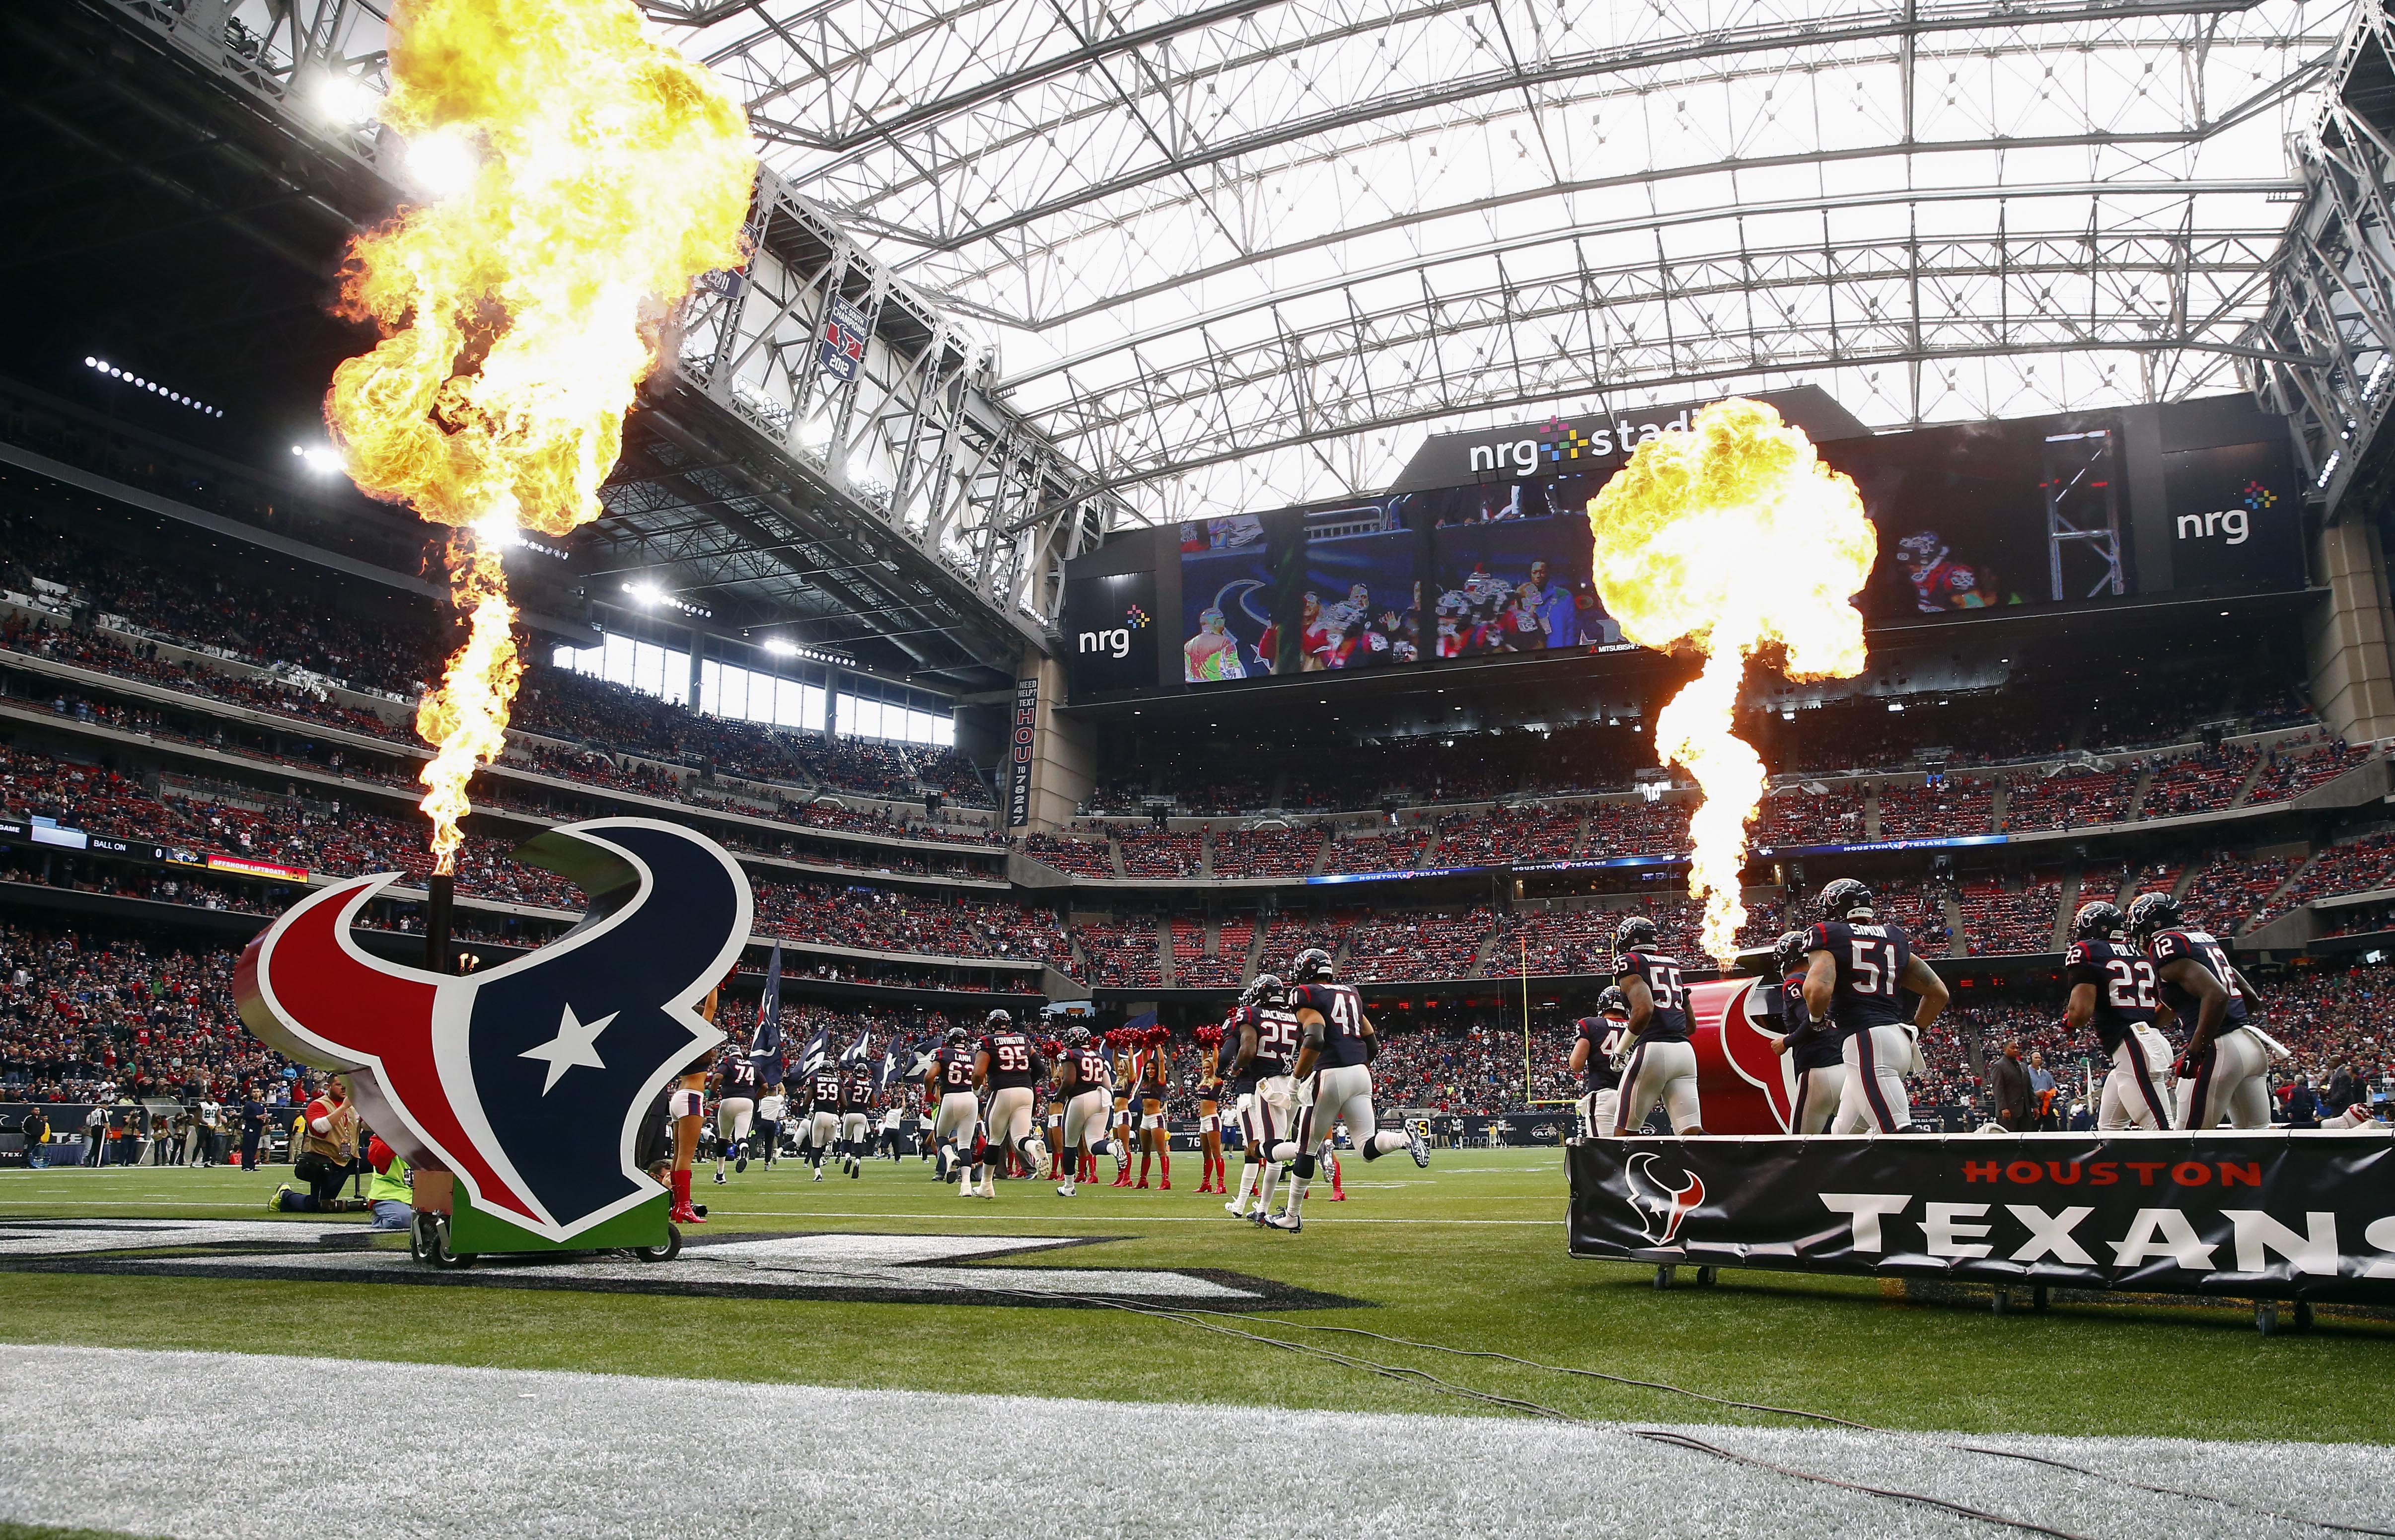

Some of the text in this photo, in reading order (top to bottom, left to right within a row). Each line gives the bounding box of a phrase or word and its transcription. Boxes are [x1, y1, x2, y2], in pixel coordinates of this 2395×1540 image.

[833, 306, 866, 336] CHAMPIONS
[839, 302, 865, 325] AFC SOUTH
[829, 354, 850, 377] 2012
[1470, 439, 1538, 476] nrg
[2177, 508, 2249, 545] nrg
[1079, 628, 1130, 658] nrg
[1017, 688, 1037, 698] HELP?
[1019, 680, 1037, 689] NEED
[1019, 698, 1035, 707] TEXT
[1015, 708, 1034, 763] HOU
[1013, 775, 1026, 825] 78247
[0, 824, 20, 833] GAME
[93, 839, 126, 851] BALL ON
[155, 848, 162, 858] 0
[1843, 844, 1888, 852] HOUSTON
[213, 860, 286, 876] OFFSHORE LIFTBOATS
[1849, 923, 1887, 938] SIMON
[2065, 949, 2082, 966] 22
[2155, 938, 2175, 959] 12
[1612, 956, 1628, 975] 55
[1851, 940, 1896, 995] 51
[2205, 947, 2242, 996] 12
[1649, 966, 1683, 1010] 55
[2105, 959, 2156, 1008] 22
[1260, 1009, 1298, 1023] JACKSON
[1330, 993, 1361, 1036] 41
[993, 1036, 1025, 1046] COVINGTON
[1256, 1021, 1298, 1060] 25
[954, 1053, 971, 1062] LAMM
[998, 1046, 1029, 1070] 95
[734, 1065, 755, 1086] 74
[947, 1061, 975, 1085] 63
[1081, 1057, 1104, 1082] 92
[817, 1083, 838, 1100] 59
[852, 1086, 872, 1103] 27
[204, 1109, 217, 1118] 80
[1419, 1122, 1427, 1135] 5
[1186, 1137, 1201, 1148] 76
[1960, 1160, 2261, 1187] HOUSTON
